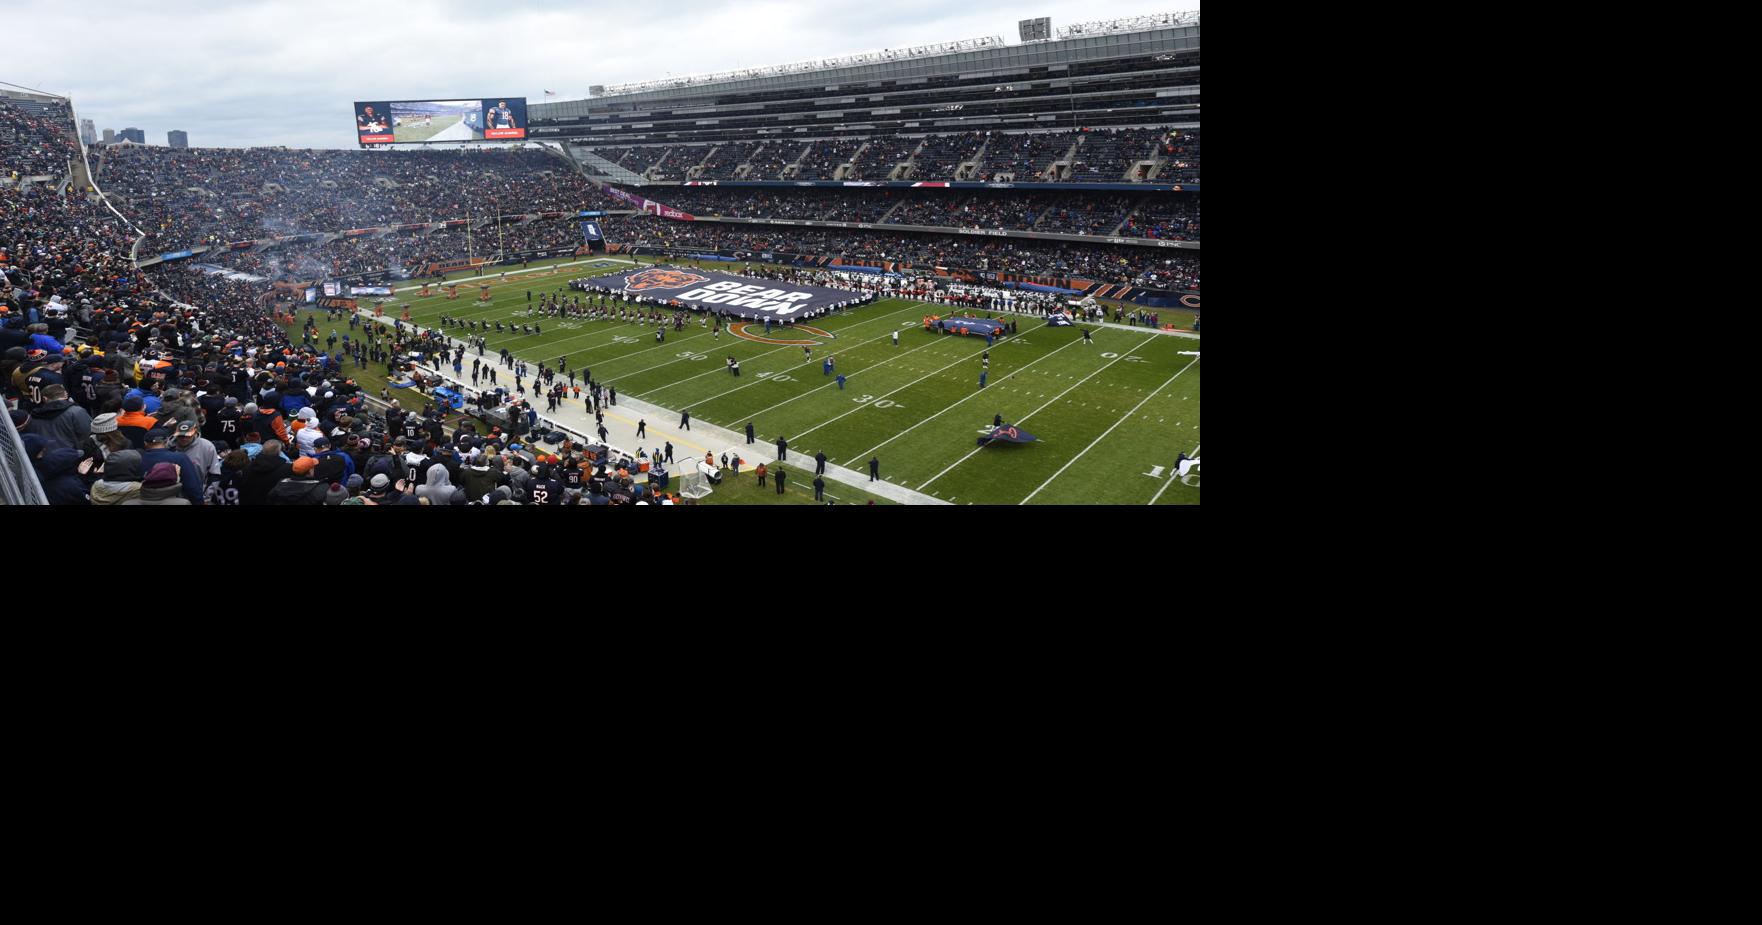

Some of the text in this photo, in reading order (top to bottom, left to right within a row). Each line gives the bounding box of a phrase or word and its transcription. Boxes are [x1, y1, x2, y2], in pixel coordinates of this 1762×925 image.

[502, 111, 509, 120] 18
[703, 281, 814, 302] BEAR
[675, 288, 808, 315] DOWN
[755, 371, 791, 382] 40
[852, 394, 895, 408] 30
[220, 420, 236, 433] 75
[568, 475, 578, 484] 90
[533, 490, 548, 504] 52
